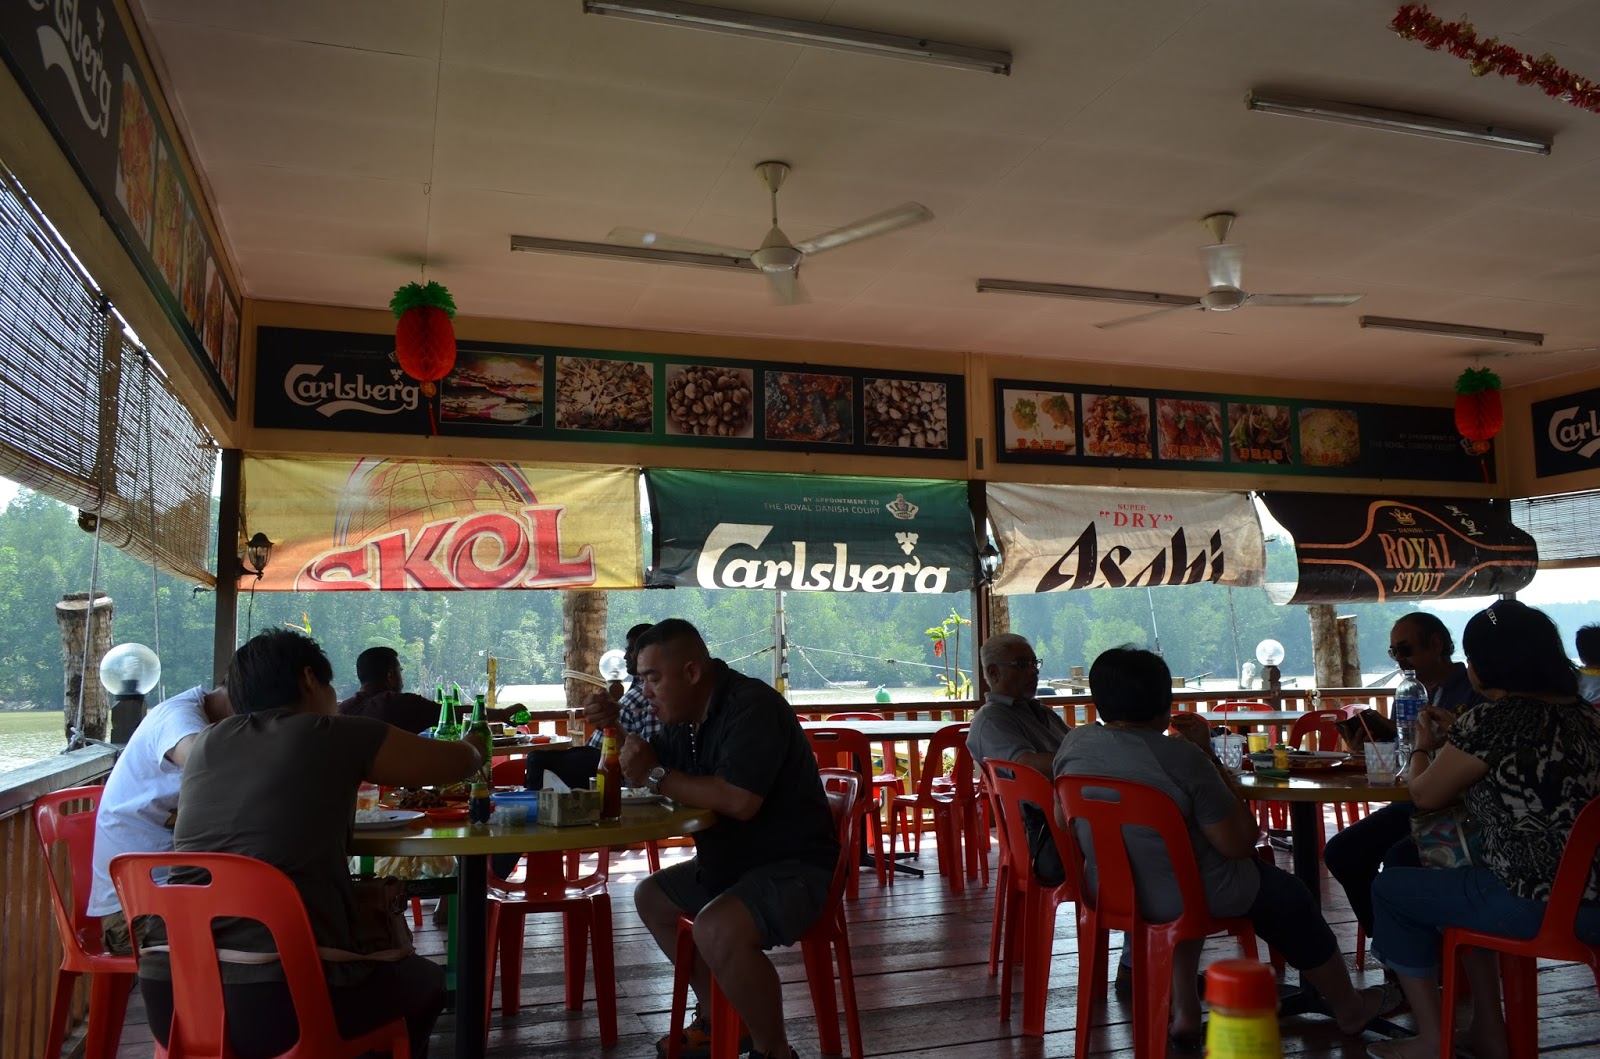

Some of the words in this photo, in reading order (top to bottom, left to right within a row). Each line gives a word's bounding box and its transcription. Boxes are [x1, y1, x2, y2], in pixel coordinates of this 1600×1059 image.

[28, 0, 112, 138] sberg
[284, 363, 420, 412] Carlsberg
[1548, 406, 1600, 452] Carl
[764, 502, 781, 510] THE
[784, 503, 812, 512] ROYAL
[815, 505, 849, 513] DANISH
[851, 506, 881, 515] COURT
[816, 497, 867, 505] APPOINTMENT
[1117, 503, 1147, 511] SUPER
[296, 503, 596, 592] SKOL
[696, 522, 951, 594] Carlsberg
[1034, 520, 1225, 593] Asahi
[1377, 533, 1457, 569] ROYAL
[1392, 571, 1446, 593] STOUT
